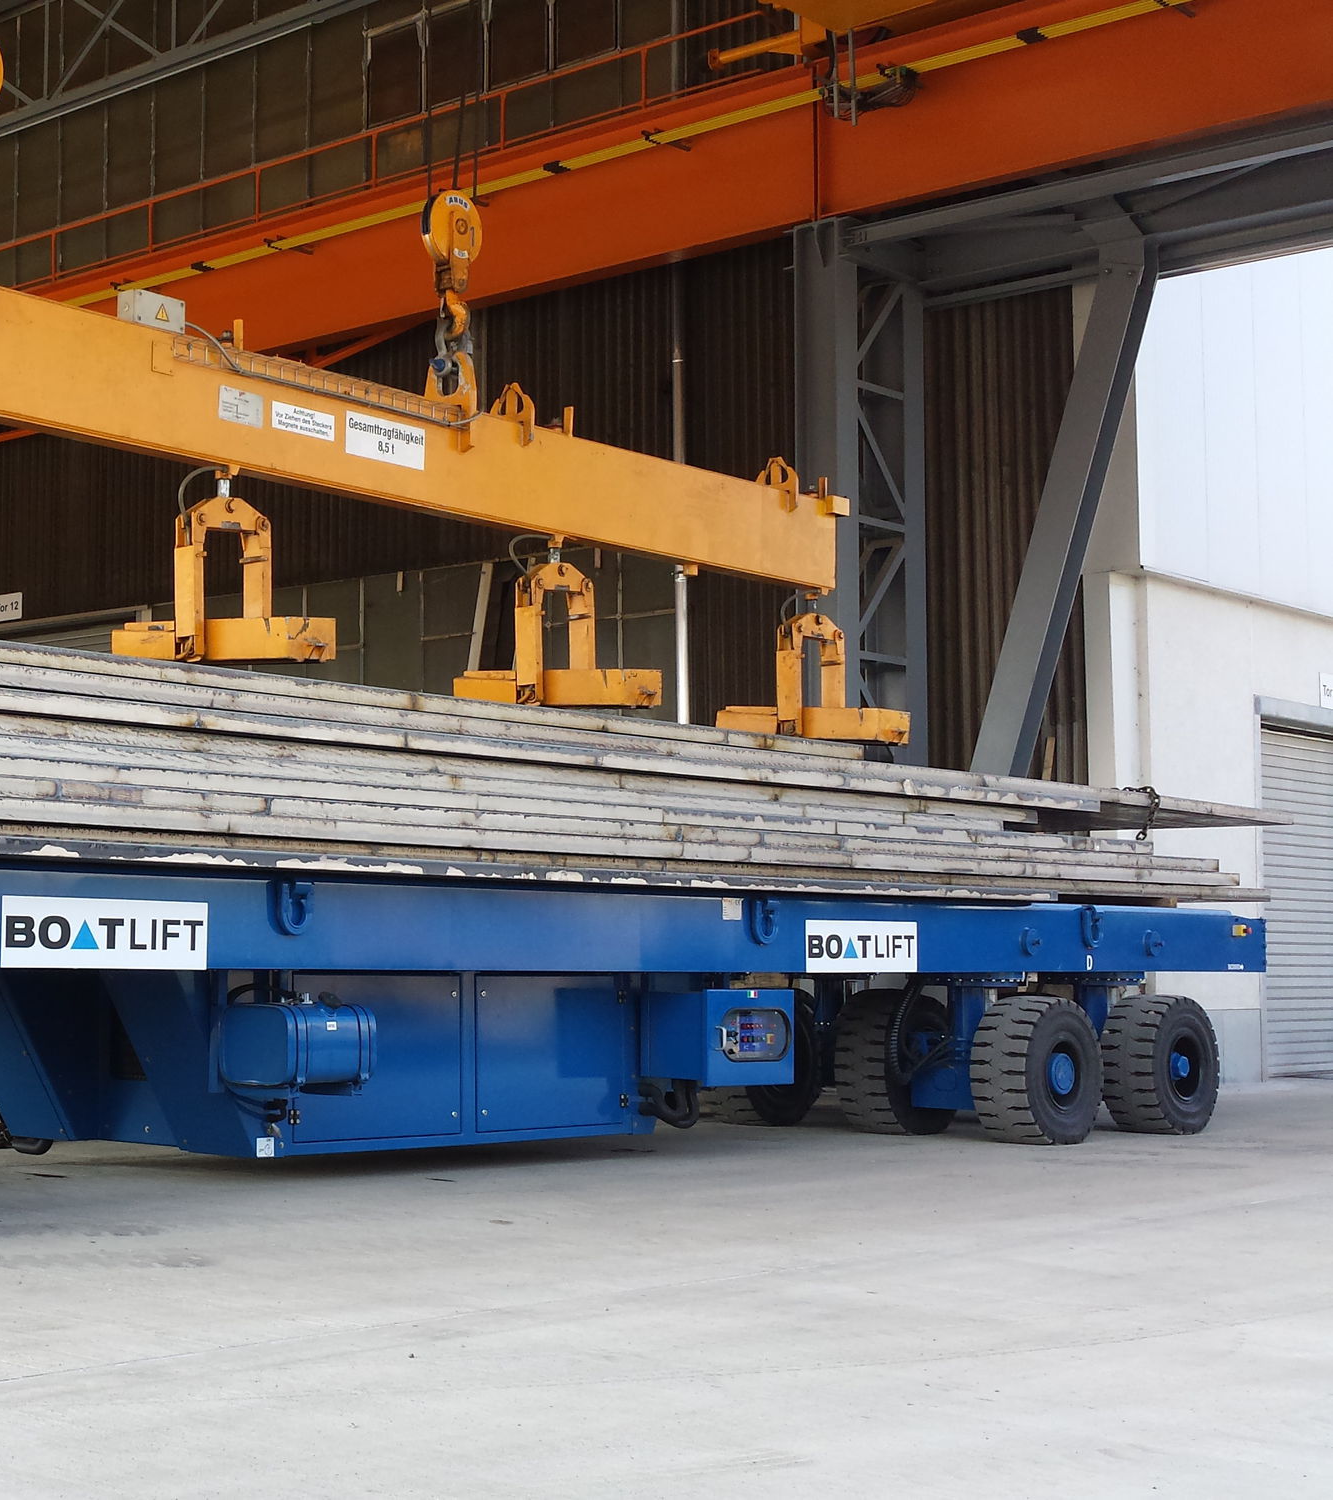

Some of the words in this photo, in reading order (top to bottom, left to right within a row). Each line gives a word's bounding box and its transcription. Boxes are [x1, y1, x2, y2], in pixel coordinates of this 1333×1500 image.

[448, 196, 469, 209] ABUS
[470, 226, 475, 247] 1
[284, 413, 301, 422] Ziehen
[293, 408, 315, 419] Achtung!
[278, 419, 298, 428] Magnete
[348, 417, 424, 446] Gesamttragfähigkeit
[378, 440, 390, 454] 8,5
[10, 600, 19, 611] 12
[5, 915, 204, 951] BOATLIFT
[807, 934, 915, 959] BOATLIFT
[1086, 955, 1093, 971] D
